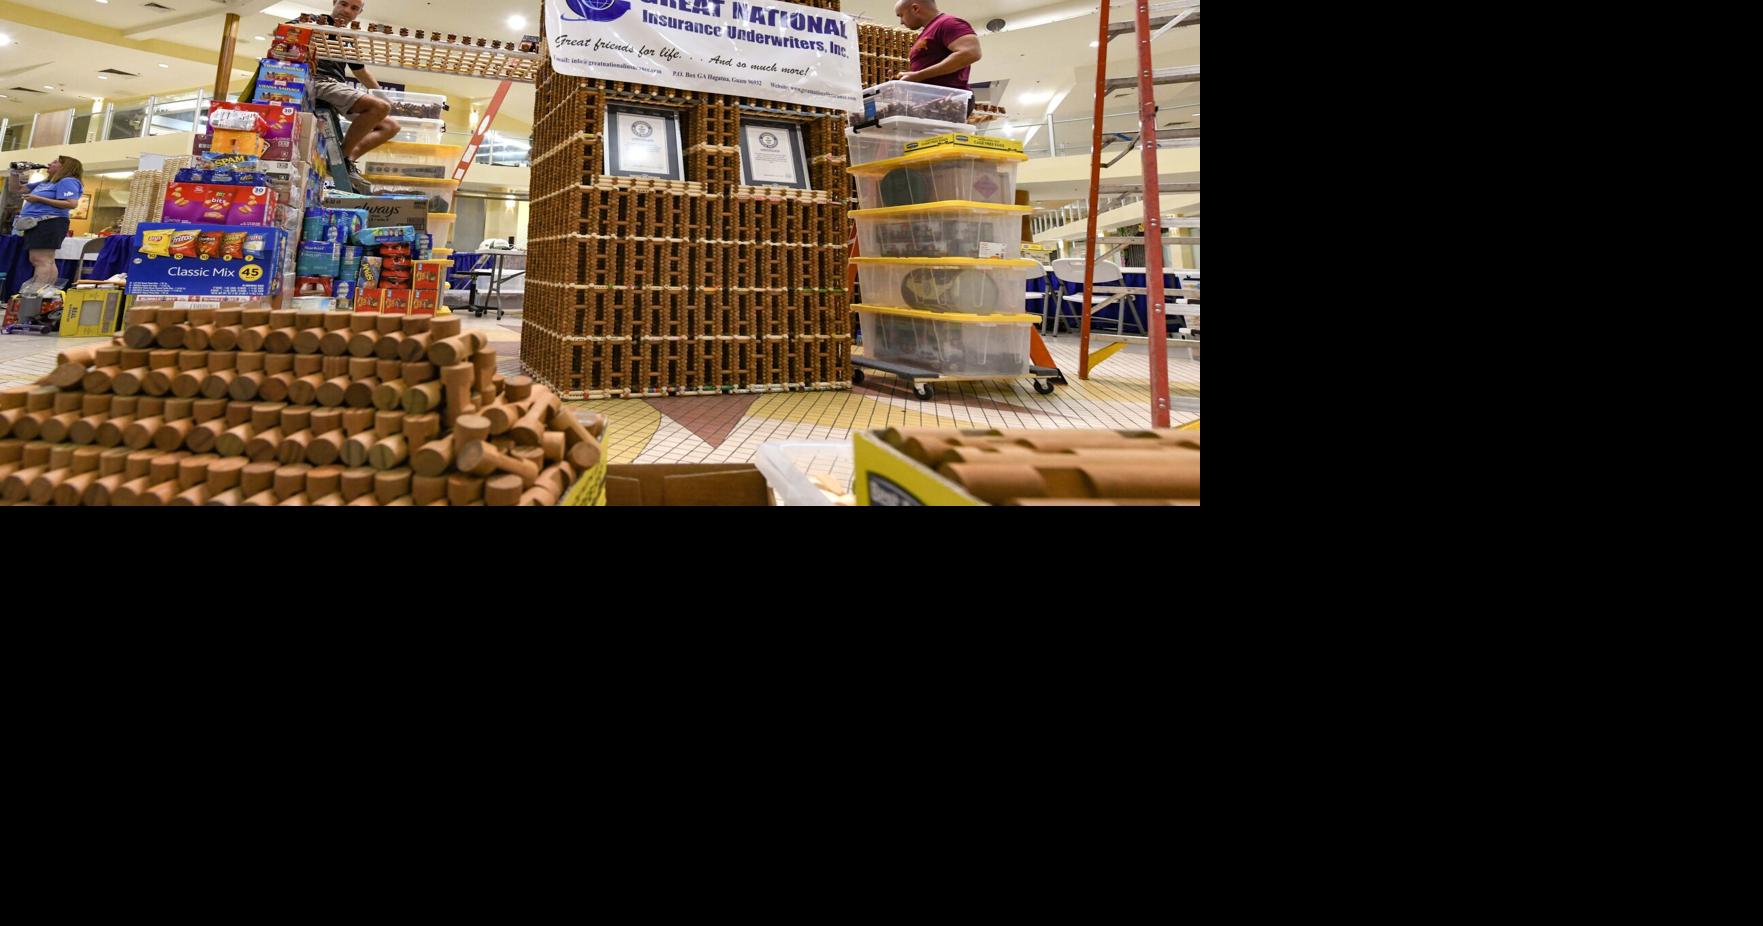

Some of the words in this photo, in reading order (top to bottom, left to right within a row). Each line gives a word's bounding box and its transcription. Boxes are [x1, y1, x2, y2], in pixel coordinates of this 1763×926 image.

[639, 0, 725, 17] EAT
[732, 2, 848, 39] NATIONAL
[642, 9, 722, 37] Insurance
[727, 26, 828, 53] Underwriters,
[829, 41, 849, 59] Inc.
[554, 35, 590, 48] Great
[593, 38, 634, 53] friends
[638, 45, 656, 57] for
[708, 55, 732, 67] And
[736, 61, 747, 69] so
[750, 63, 777, 72] much
[781, 67, 810, 77] more!
[214, 155, 246, 168] SPAM
[168, 266, 210, 277] Classic
[212, 267, 236, 277] Mix
[241, 268, 259, 277] 45
